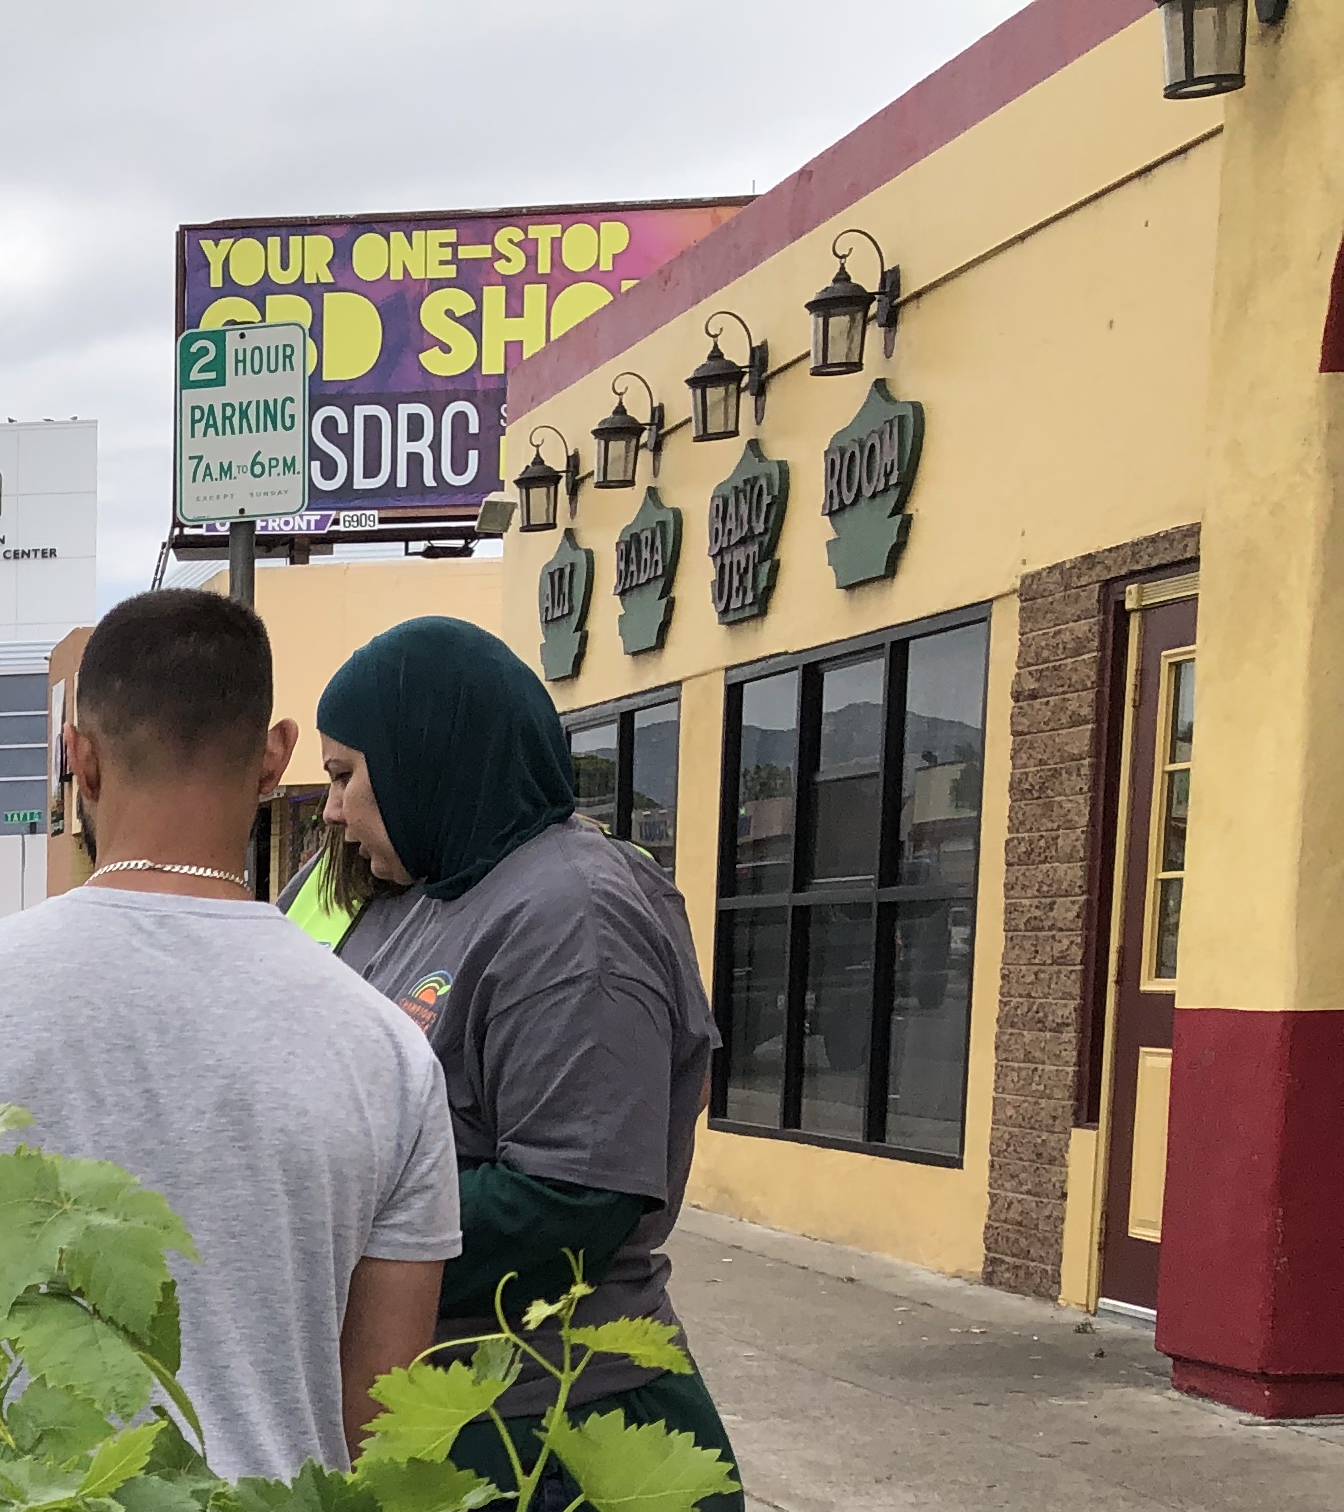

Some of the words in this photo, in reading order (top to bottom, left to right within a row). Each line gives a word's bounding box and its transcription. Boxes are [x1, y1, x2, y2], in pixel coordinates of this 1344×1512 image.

[199, 233, 335, 288] YOUR
[351, 221, 632, 282] ONE-STOP
[188, 338, 218, 382] 2
[233, 343, 297, 378] HOUR
[418, 279, 640, 377] SHO
[189, 396, 297, 439] PARKING
[311, 400, 480, 492] SDRC
[196, 493, 235, 502] EXCEPT
[249, 489, 289, 498] SUNDAY
[821, 414, 901, 517] ROOM
[215, 514, 321, 532] OFRONT
[342, 513, 377, 529] 6909
[2, 547, 58, 560] CENTER
[614, 519, 669, 597] BABA
[713, 543, 759, 613] UET
[542, 561, 576, 625] ALI
